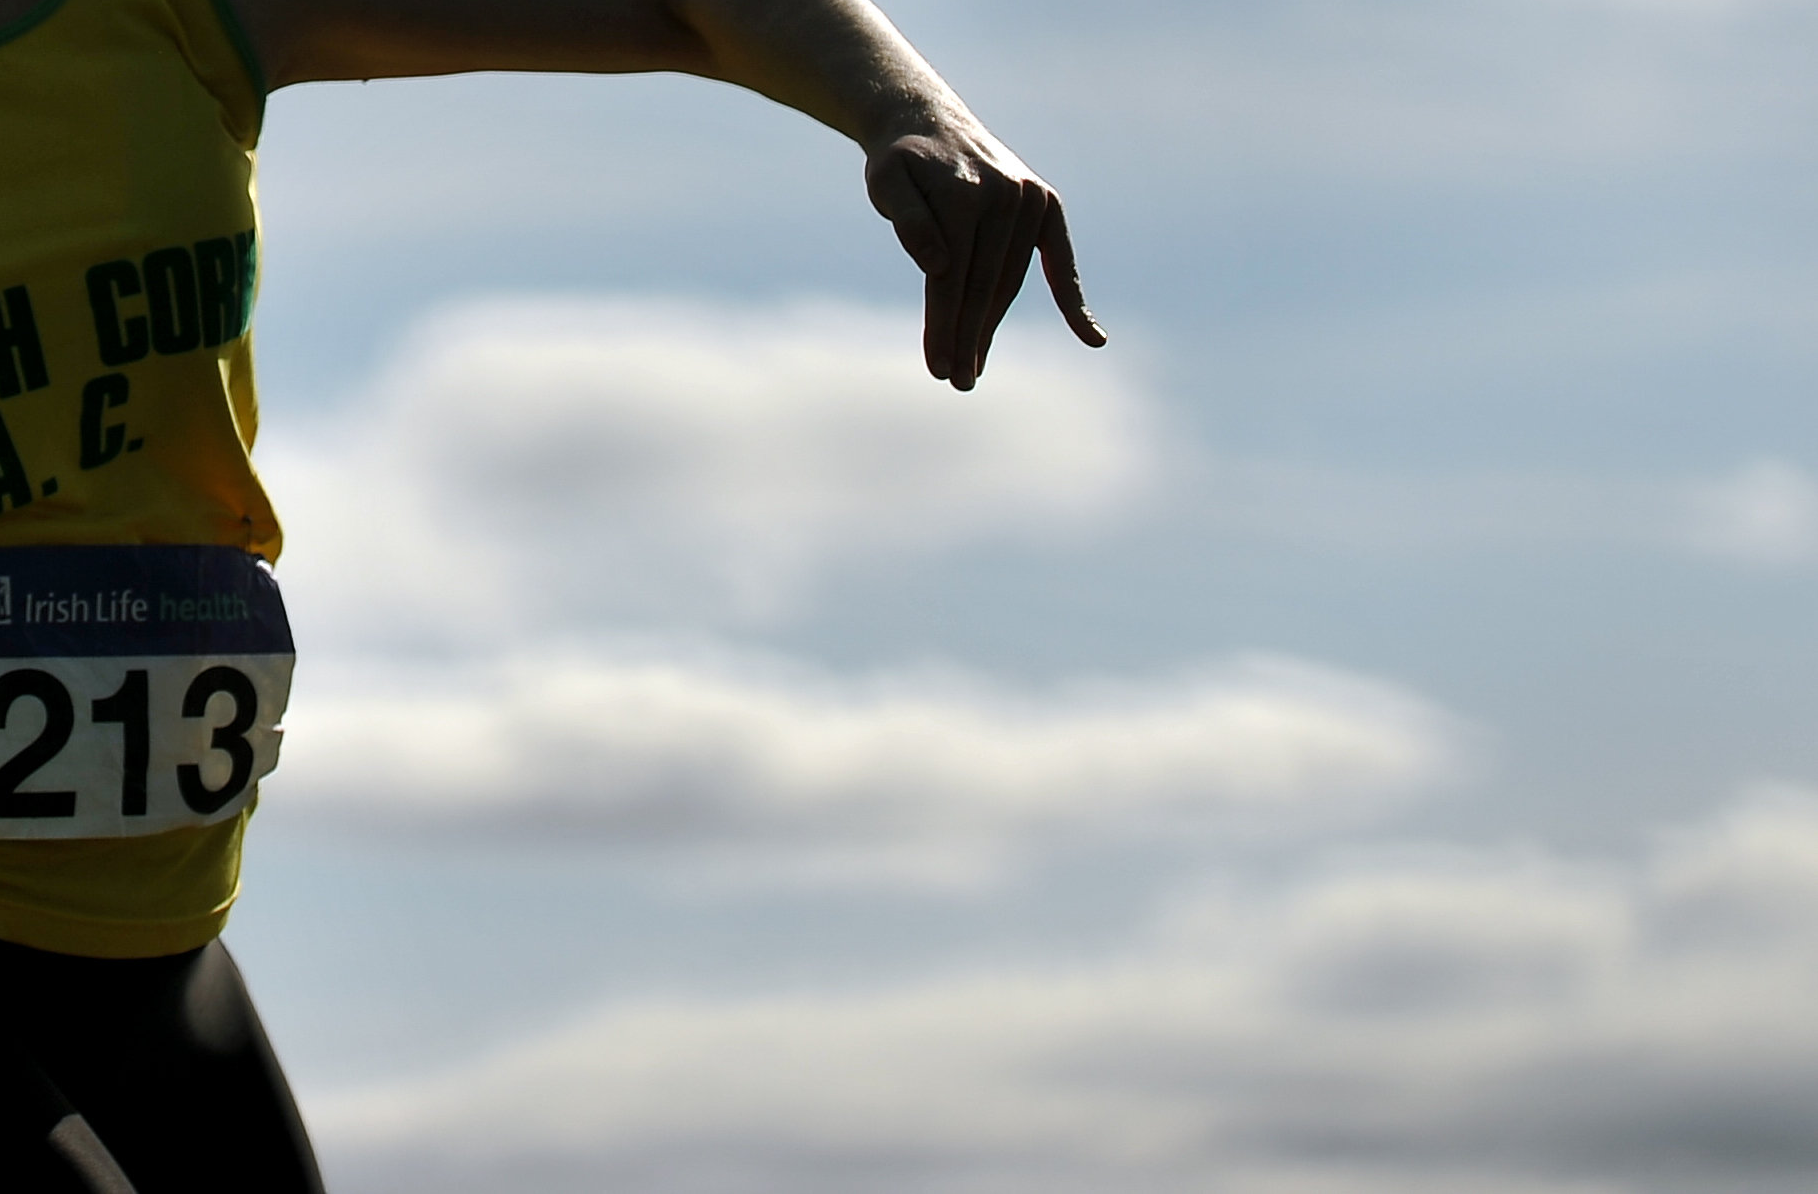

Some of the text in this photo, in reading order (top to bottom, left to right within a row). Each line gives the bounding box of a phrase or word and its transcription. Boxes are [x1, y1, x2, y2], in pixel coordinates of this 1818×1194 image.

[79, 372, 145, 471] C.
[24, 588, 250, 624] Irish Life health
